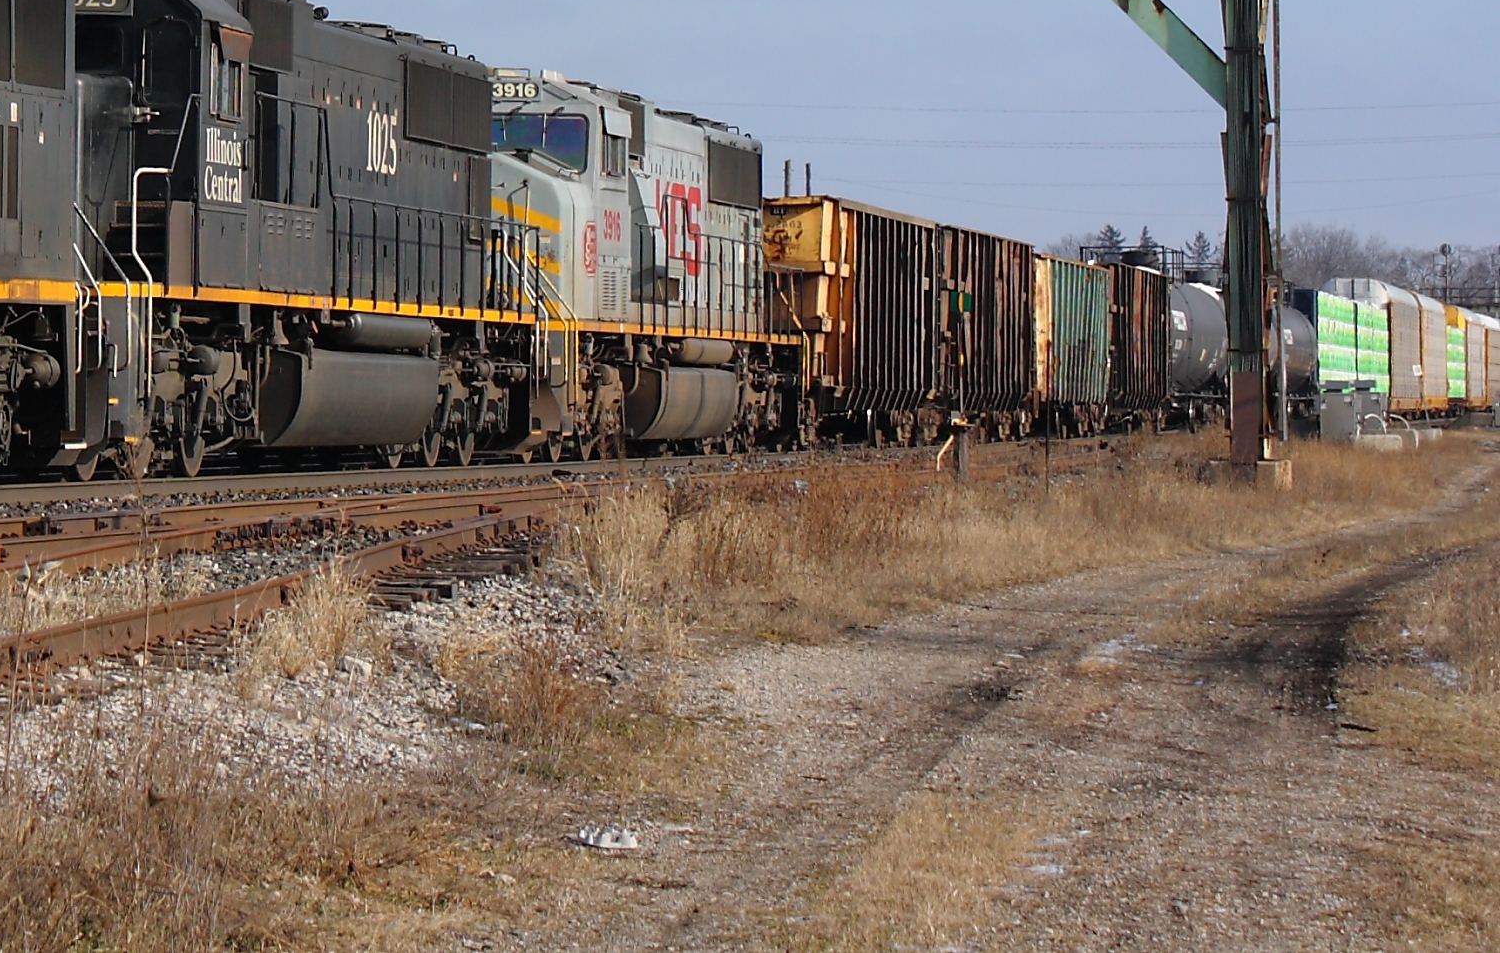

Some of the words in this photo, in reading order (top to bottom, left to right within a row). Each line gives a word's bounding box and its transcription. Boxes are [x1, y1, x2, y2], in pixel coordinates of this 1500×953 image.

[492, 83, 536, 98] 3916
[205, 127, 242, 167] Illinois
[366, 110, 397, 175] 1025
[204, 165, 242, 204] Central
[603, 209, 621, 242] 3916
[655, 178, 702, 277] KCS
